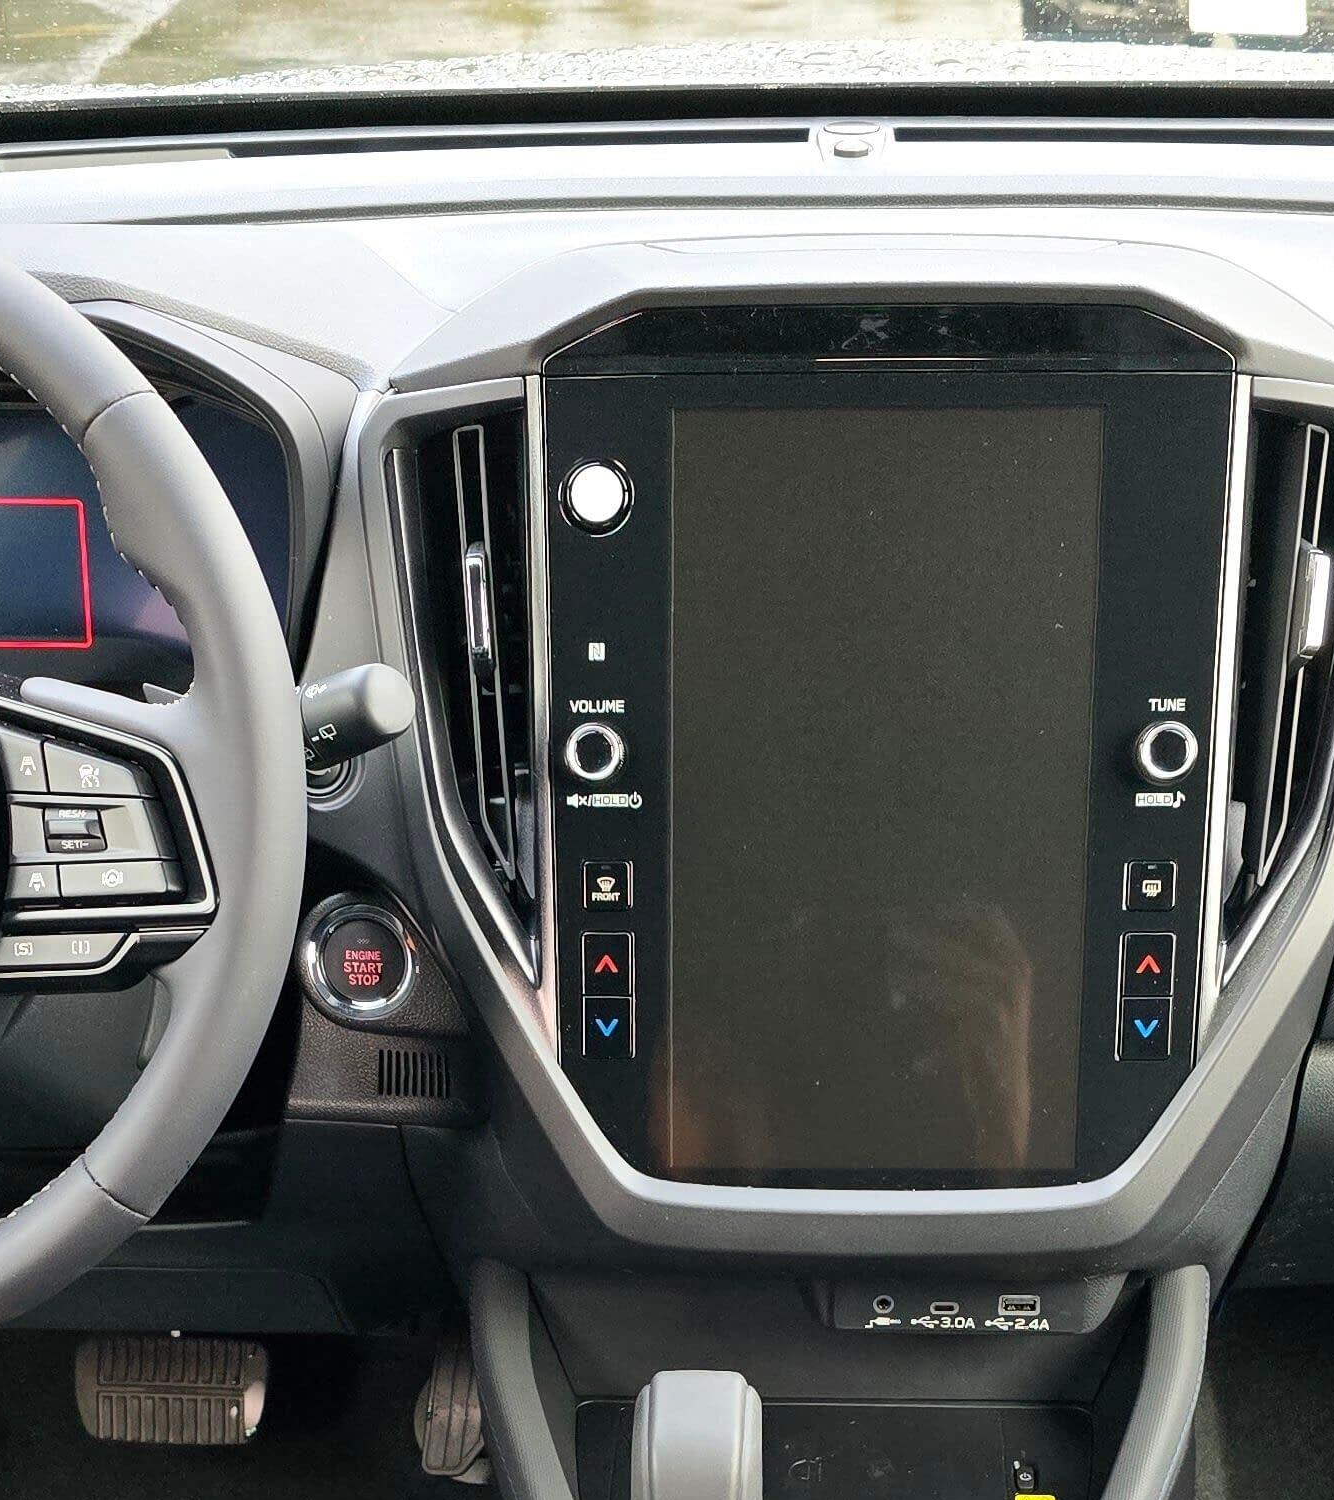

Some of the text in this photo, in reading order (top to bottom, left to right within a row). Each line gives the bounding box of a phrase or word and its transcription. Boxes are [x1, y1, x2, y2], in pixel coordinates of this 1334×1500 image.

[569, 699, 625, 714] VOLUME
[1148, 698, 1187, 712] TUNE
[592, 794, 629, 807] HOLD
[1136, 793, 1173, 806] HOLD
[591, 892, 621, 902] FRONT
[345, 949, 382, 961] ENGINE
[343, 961, 384, 973] START
[348, 973, 380, 986] STOP
[940, 1316, 975, 1329] 3.0A
[1014, 1317, 1050, 1330] 2.4A
